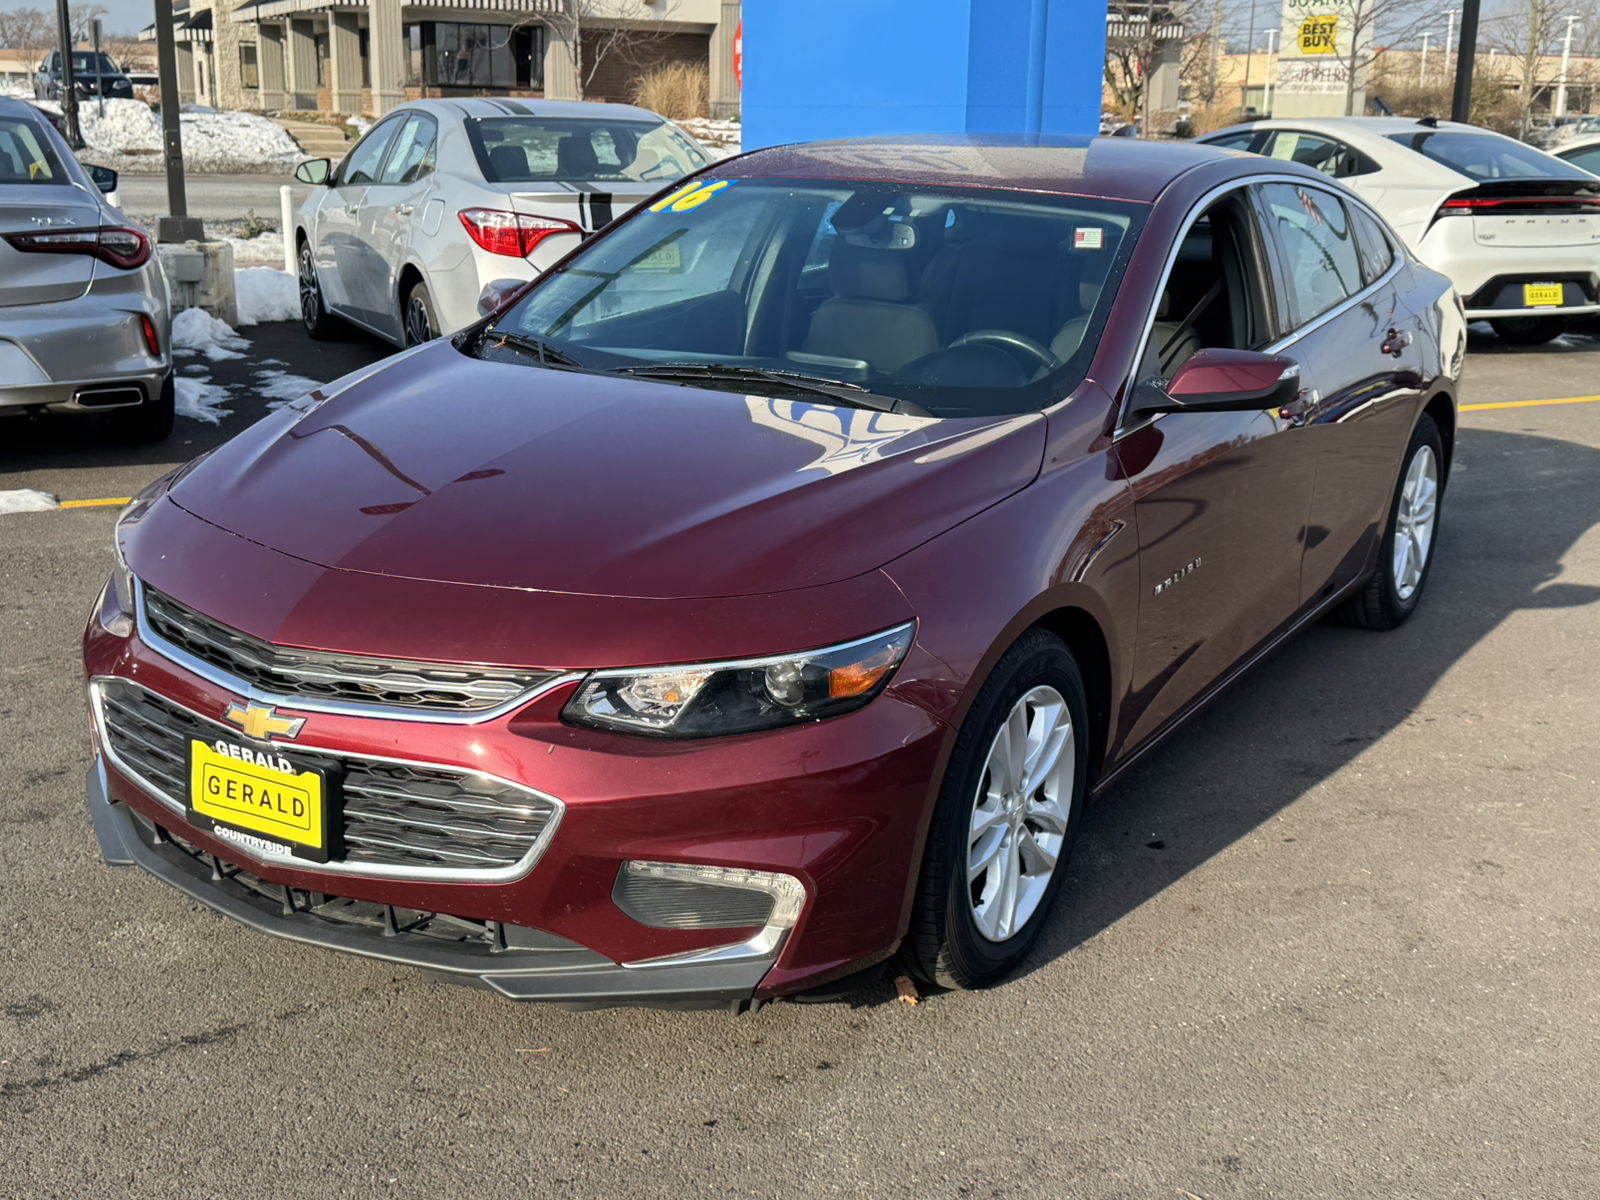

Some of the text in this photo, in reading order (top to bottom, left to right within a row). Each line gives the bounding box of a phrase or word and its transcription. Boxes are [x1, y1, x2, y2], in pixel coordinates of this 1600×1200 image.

[1303, 22, 1336, 35] BEST
[1303, 35, 1331, 48] BUY
[649, 181, 728, 212] 16
[31, 216, 77, 226] TLX
[1530, 291, 1557, 299] GERALD
[1154, 557, 1202, 597] MALIBU
[215, 740, 293, 775] GERALD
[207, 775, 305, 818] GERALD
[213, 825, 292, 856] COUNTRYSIDE
